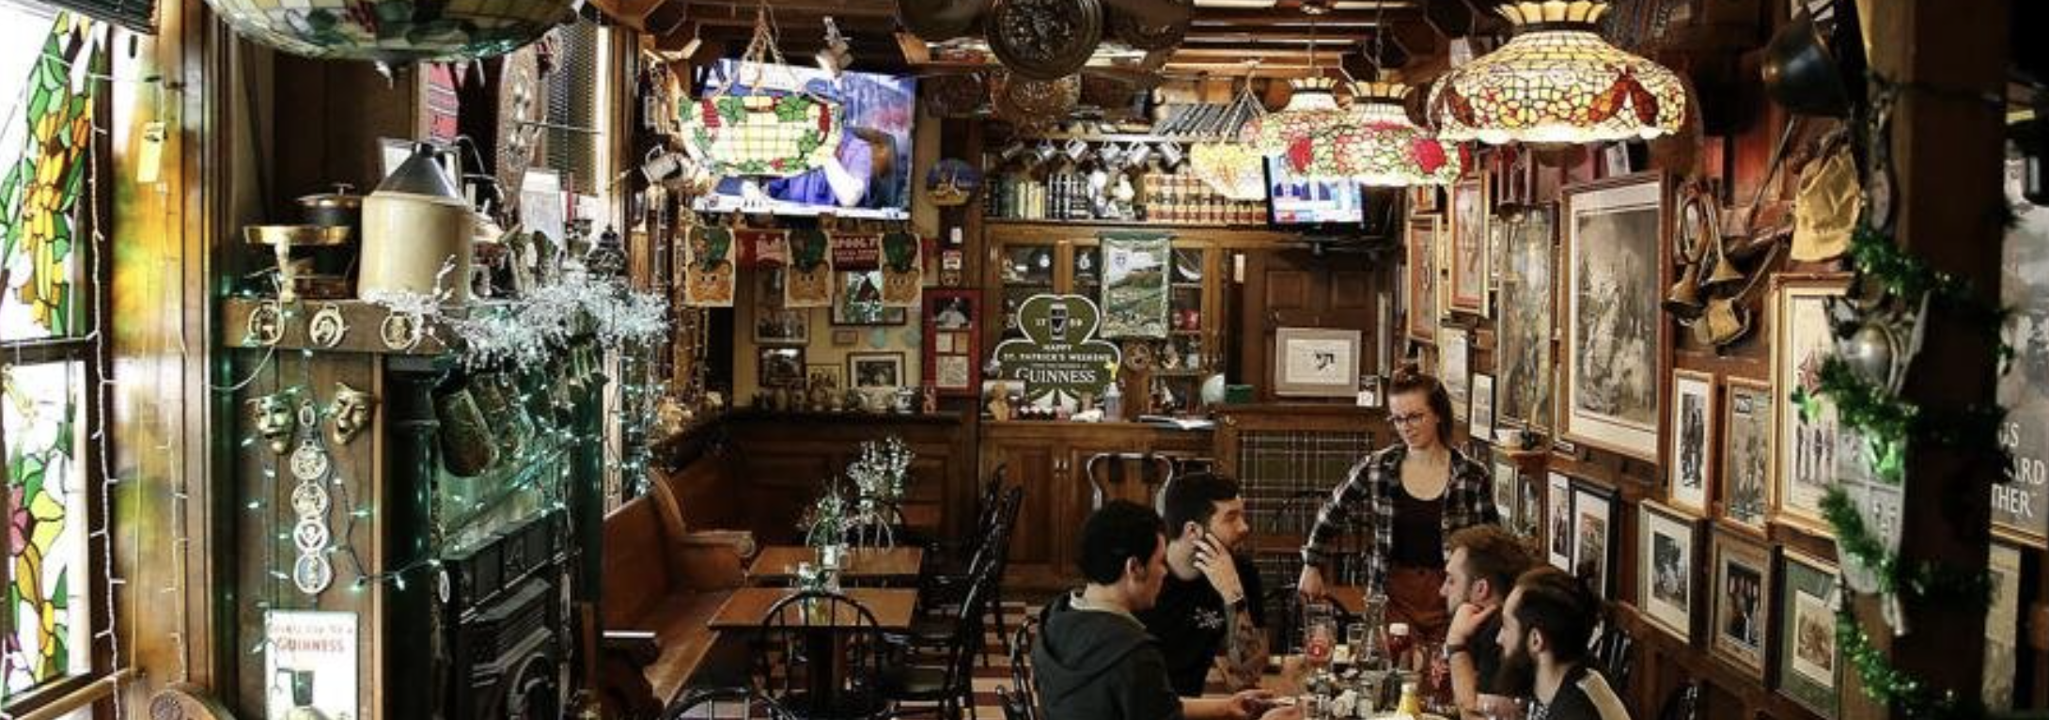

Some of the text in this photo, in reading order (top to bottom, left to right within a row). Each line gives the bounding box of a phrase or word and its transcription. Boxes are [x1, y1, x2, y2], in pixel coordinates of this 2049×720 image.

[1020, 353, 1065, 361] PATRICK'S
[1015, 367, 1096, 383] GUINNESS
[1991, 483, 2033, 518] THER
[276, 637, 344, 652] GUINNESS
